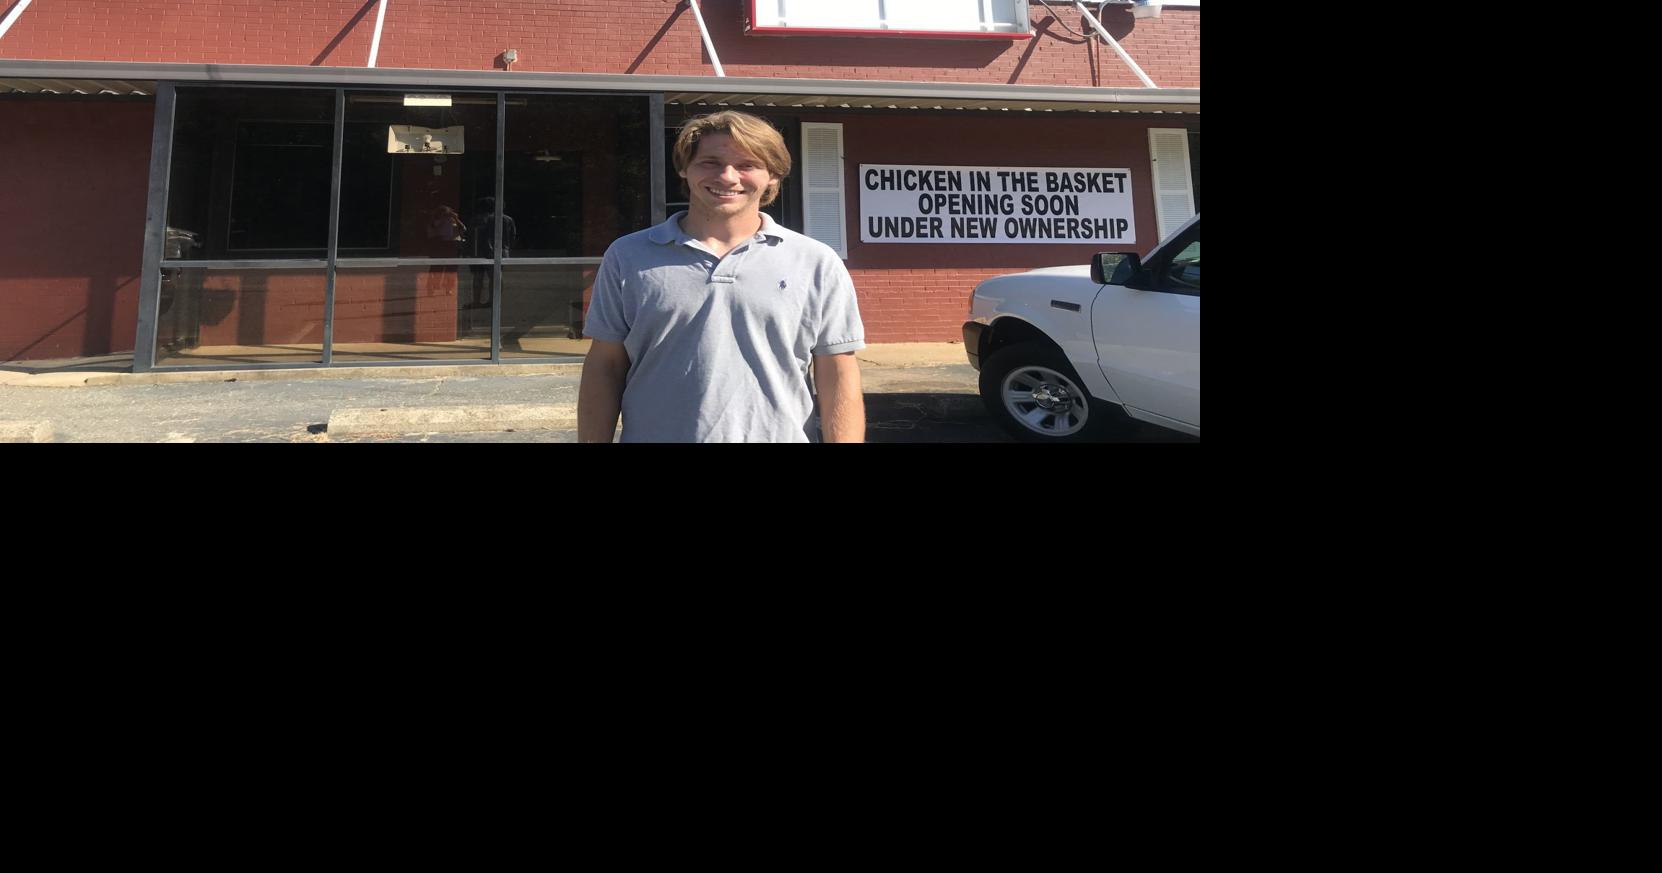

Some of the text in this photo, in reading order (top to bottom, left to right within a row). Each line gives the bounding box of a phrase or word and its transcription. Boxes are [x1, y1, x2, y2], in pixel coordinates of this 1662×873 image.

[865, 169, 1127, 193] CHICKEN IN THE BASKET
[918, 194, 1079, 216] OPENING SOON
[868, 216, 1129, 239] UNDER NEW OWNERSHIP
